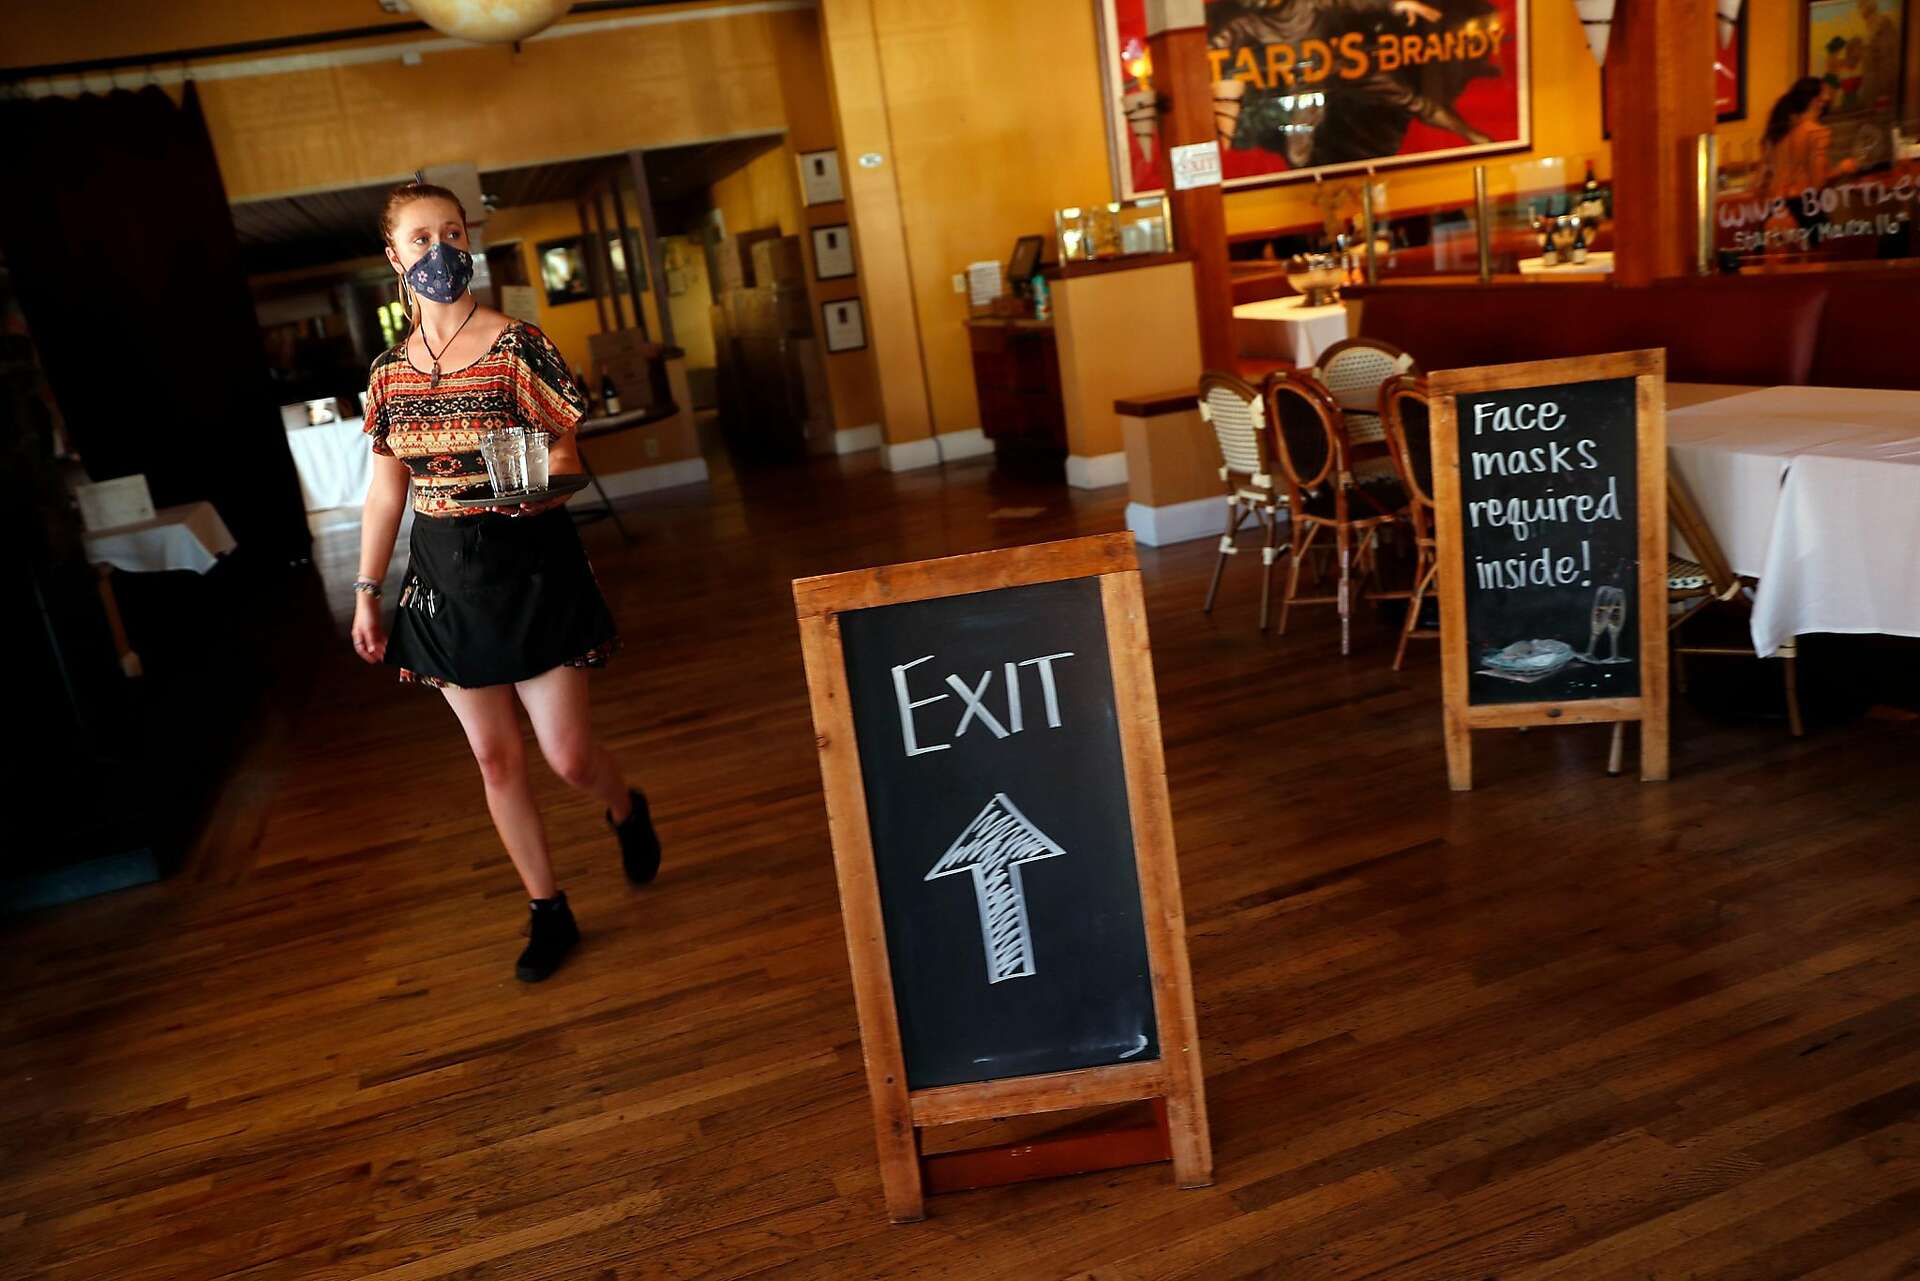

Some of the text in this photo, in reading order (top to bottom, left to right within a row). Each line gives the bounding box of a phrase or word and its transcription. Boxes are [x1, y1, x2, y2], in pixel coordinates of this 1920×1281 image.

[1378, 27, 1504, 71] BRANDY
[1473, 402, 1567, 436] Face
[1472, 439, 1599, 480] masks
[1469, 476, 1622, 541] required
[1476, 540, 1592, 590] inside!
[891, 651, 1075, 757] EXIT
